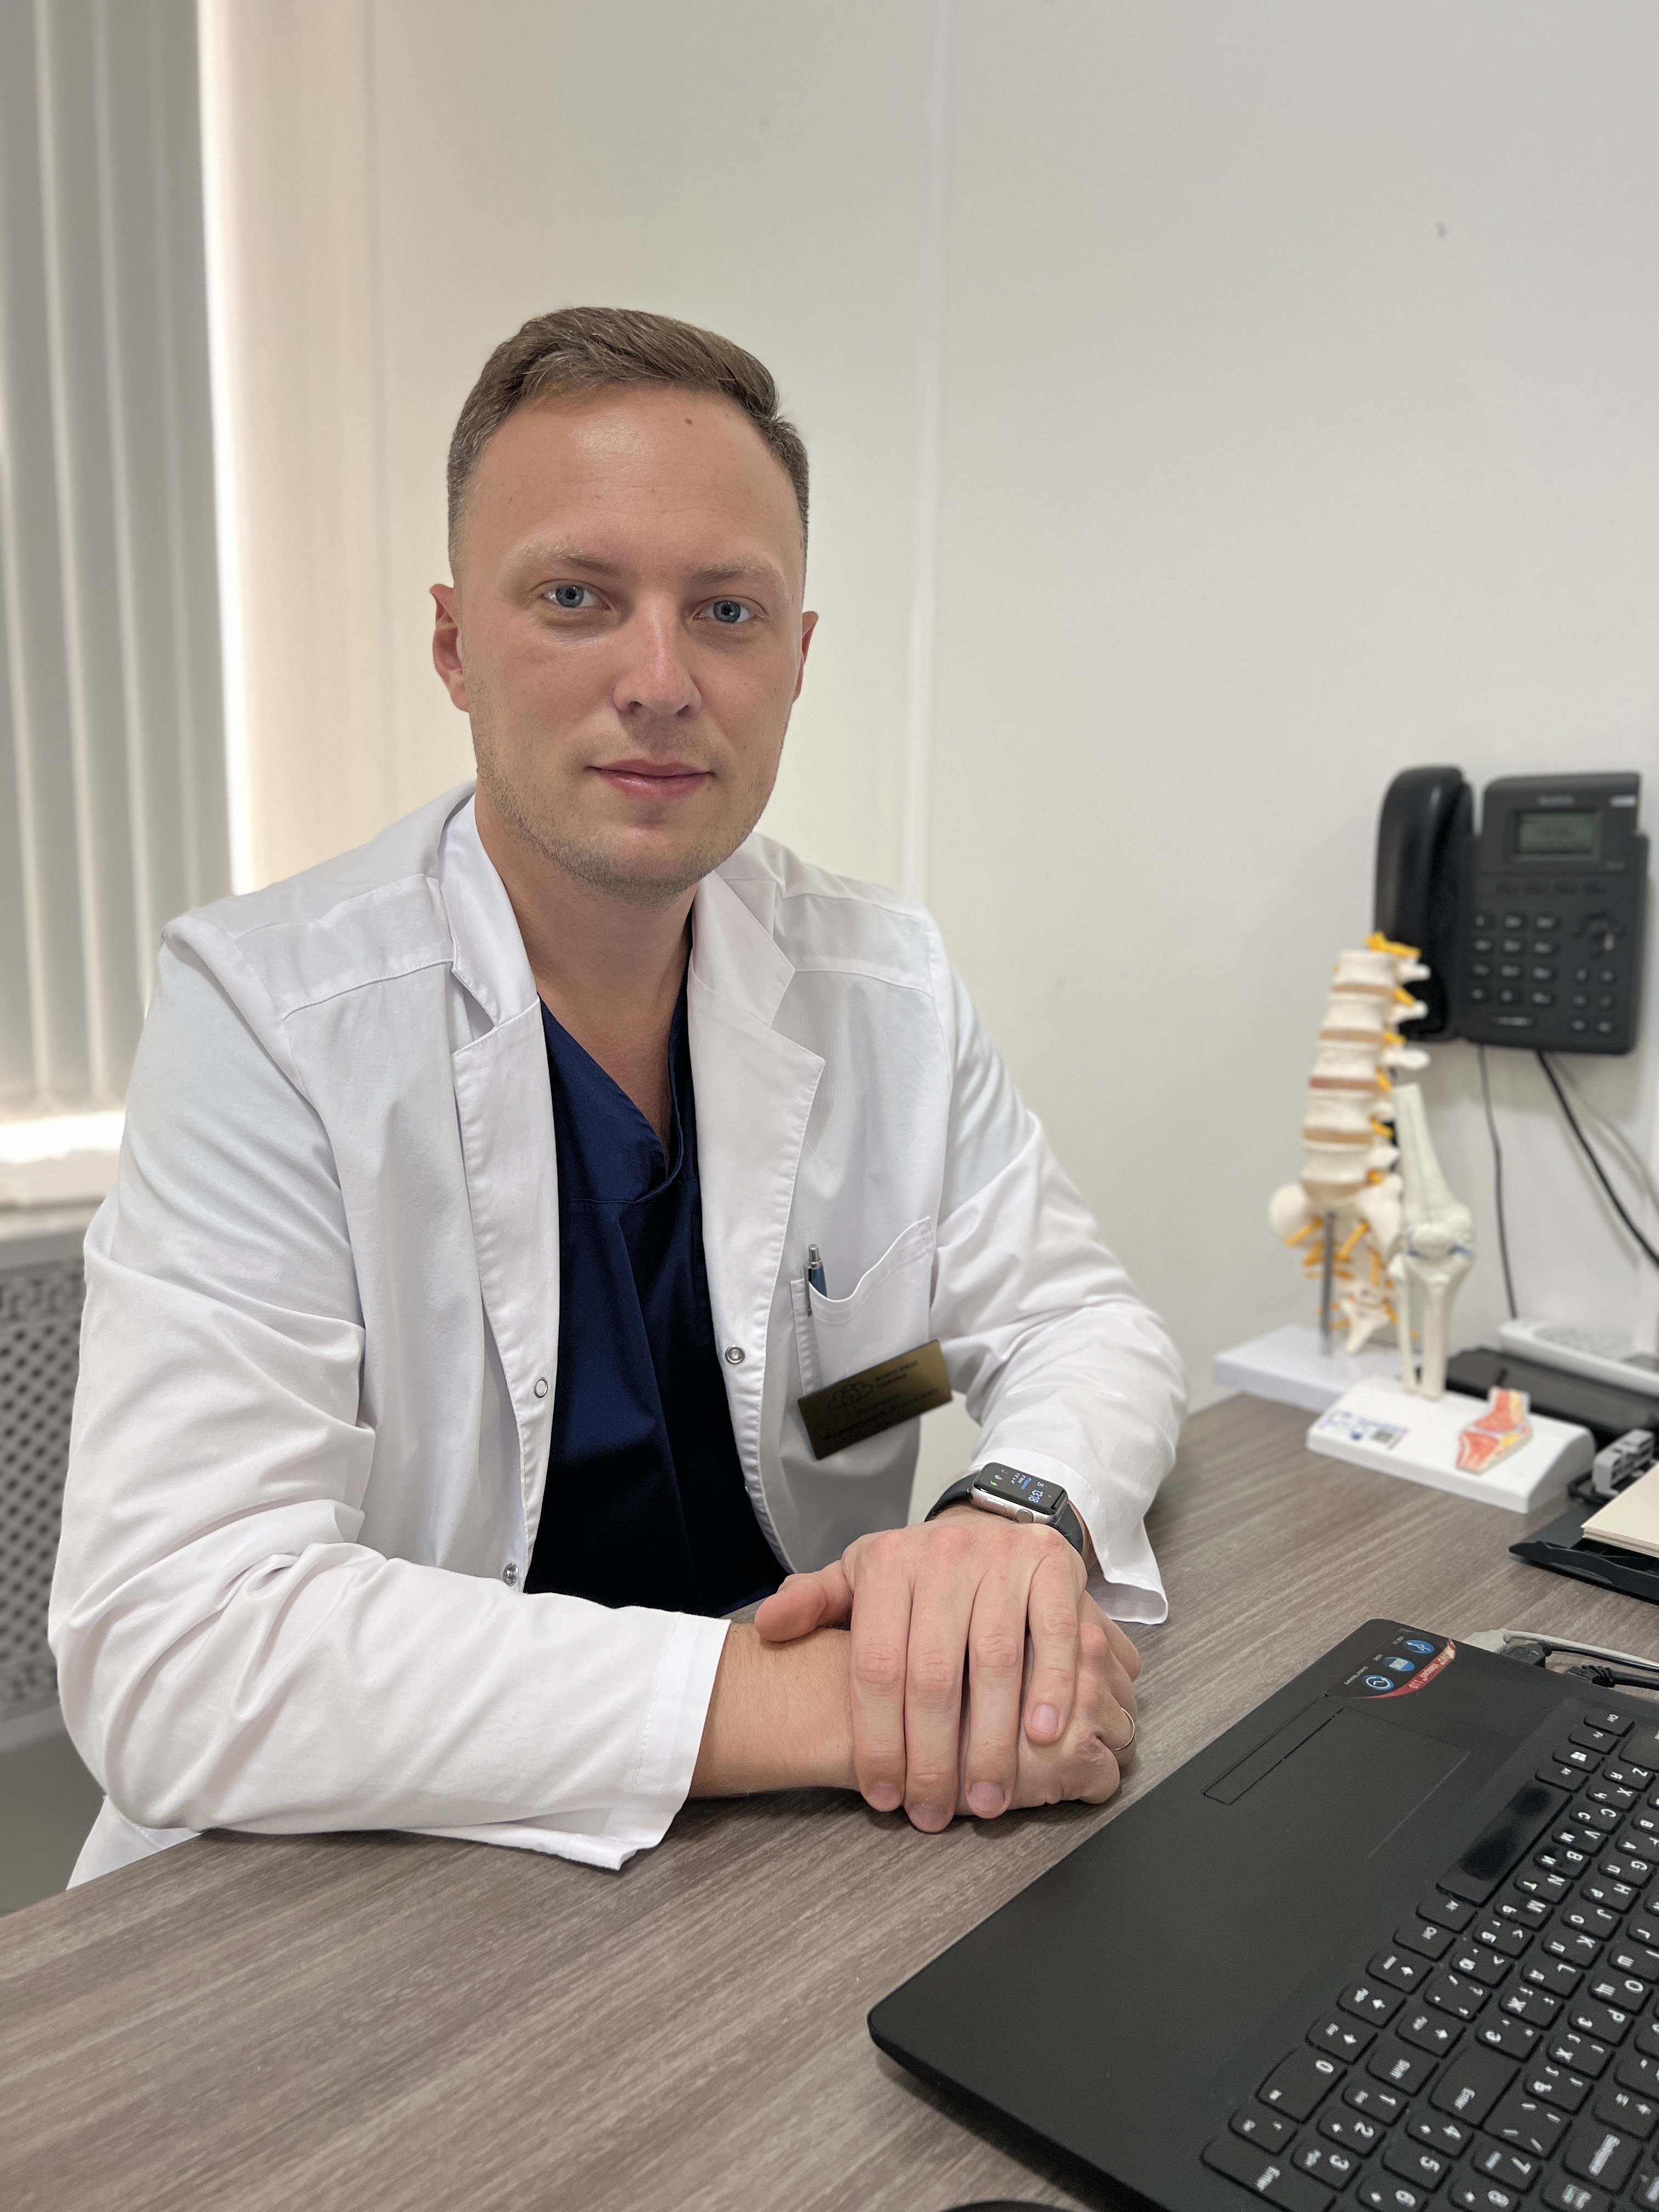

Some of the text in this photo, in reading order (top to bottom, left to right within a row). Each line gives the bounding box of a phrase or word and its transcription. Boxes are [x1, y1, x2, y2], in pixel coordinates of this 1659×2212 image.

[1409, 1679, 1423, 1689] 110
[1632, 1767, 1649, 1777] Z
[1616, 1787, 1633, 1797] X
[1600, 1808, 1617, 1818] C
[1584, 1830, 1601, 1839] V
[1566, 1850, 1584, 1861] B
[1630, 1860, 1647, 1871] G
[1547, 1874, 1566, 1886] N
[1613, 1883, 1632, 1895] H
[1527, 1899, 1546, 1913] M
[1596, 1909, 1612, 1920] J
[1576, 1935, 1596, 1949] K
[1557, 1963, 1576, 1973] L
[1607, 2008, 1626, 2023] P
[1315, 2060, 1334, 2074] 0
[1379, 2094, 1396, 2106] 1
[1354, 2121, 1374, 2138] 2
[1329, 2154, 1350, 2170] 3
[1419, 2156, 1440, 2172] 5
[1511, 2158, 1532, 2174] 7
[1395, 2190, 1416, 2207] 6
[1487, 2190, 1509, 2207] 8
